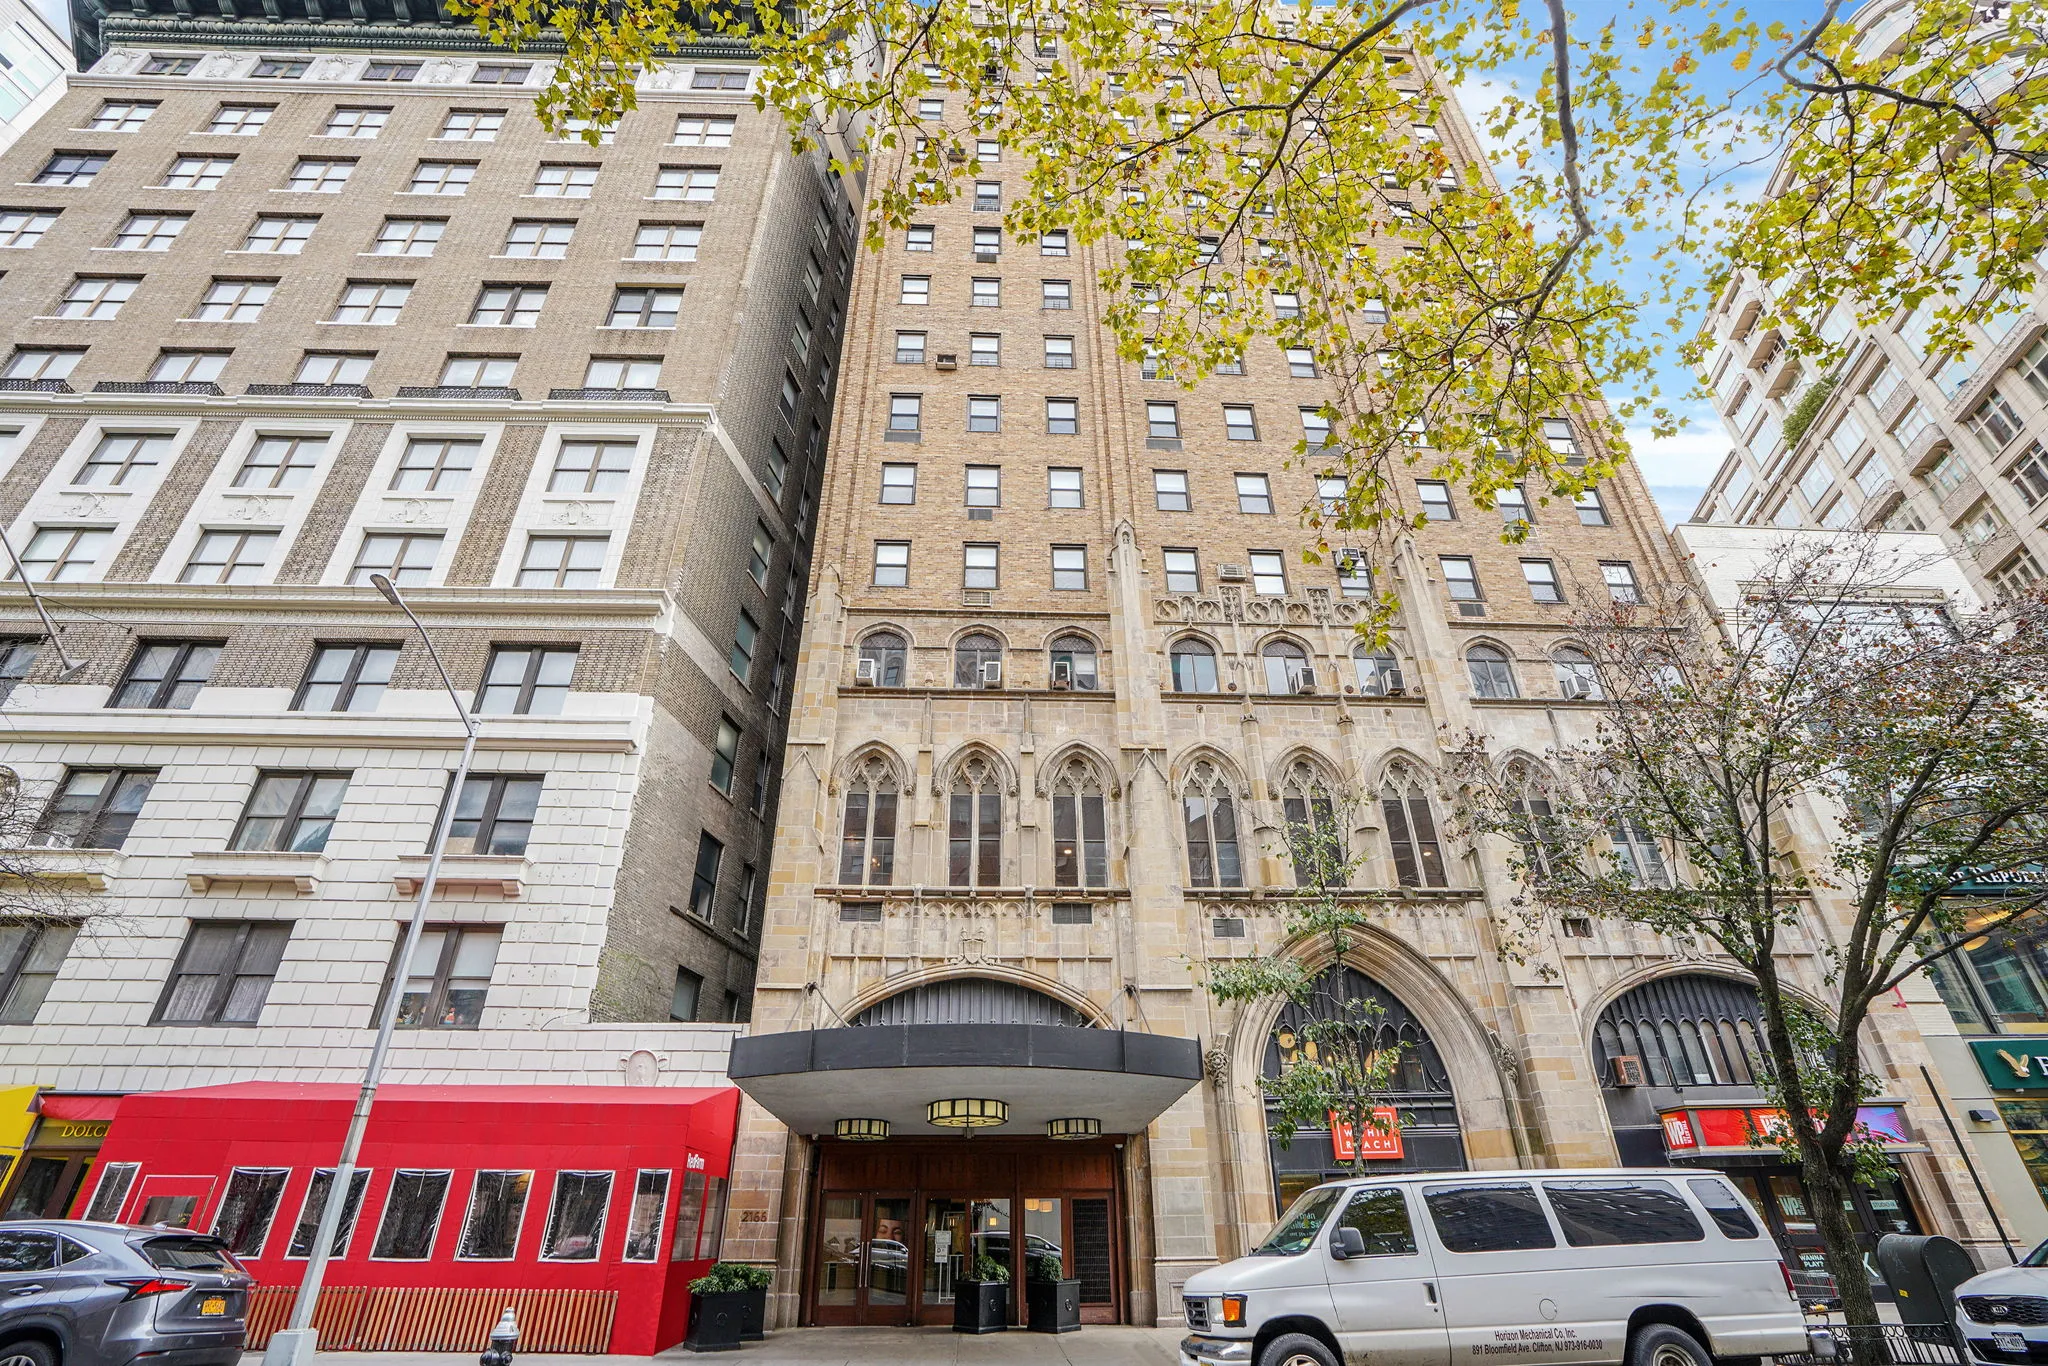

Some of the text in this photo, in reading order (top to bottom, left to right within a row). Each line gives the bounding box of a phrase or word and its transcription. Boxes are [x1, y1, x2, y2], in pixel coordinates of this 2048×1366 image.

[1345, 1140, 1391, 1150] RACH
[741, 1211, 768, 1222] 2166
[1494, 1330, 1519, 1341] Horizon
[1519, 1328, 1554, 1340] Mechanical
[1565, 1328, 1577, 1338] Inc.
[1472, 1339, 1603, 1355] 891 Bloomfield Ave. Clifton, NJ 973-916-0030
